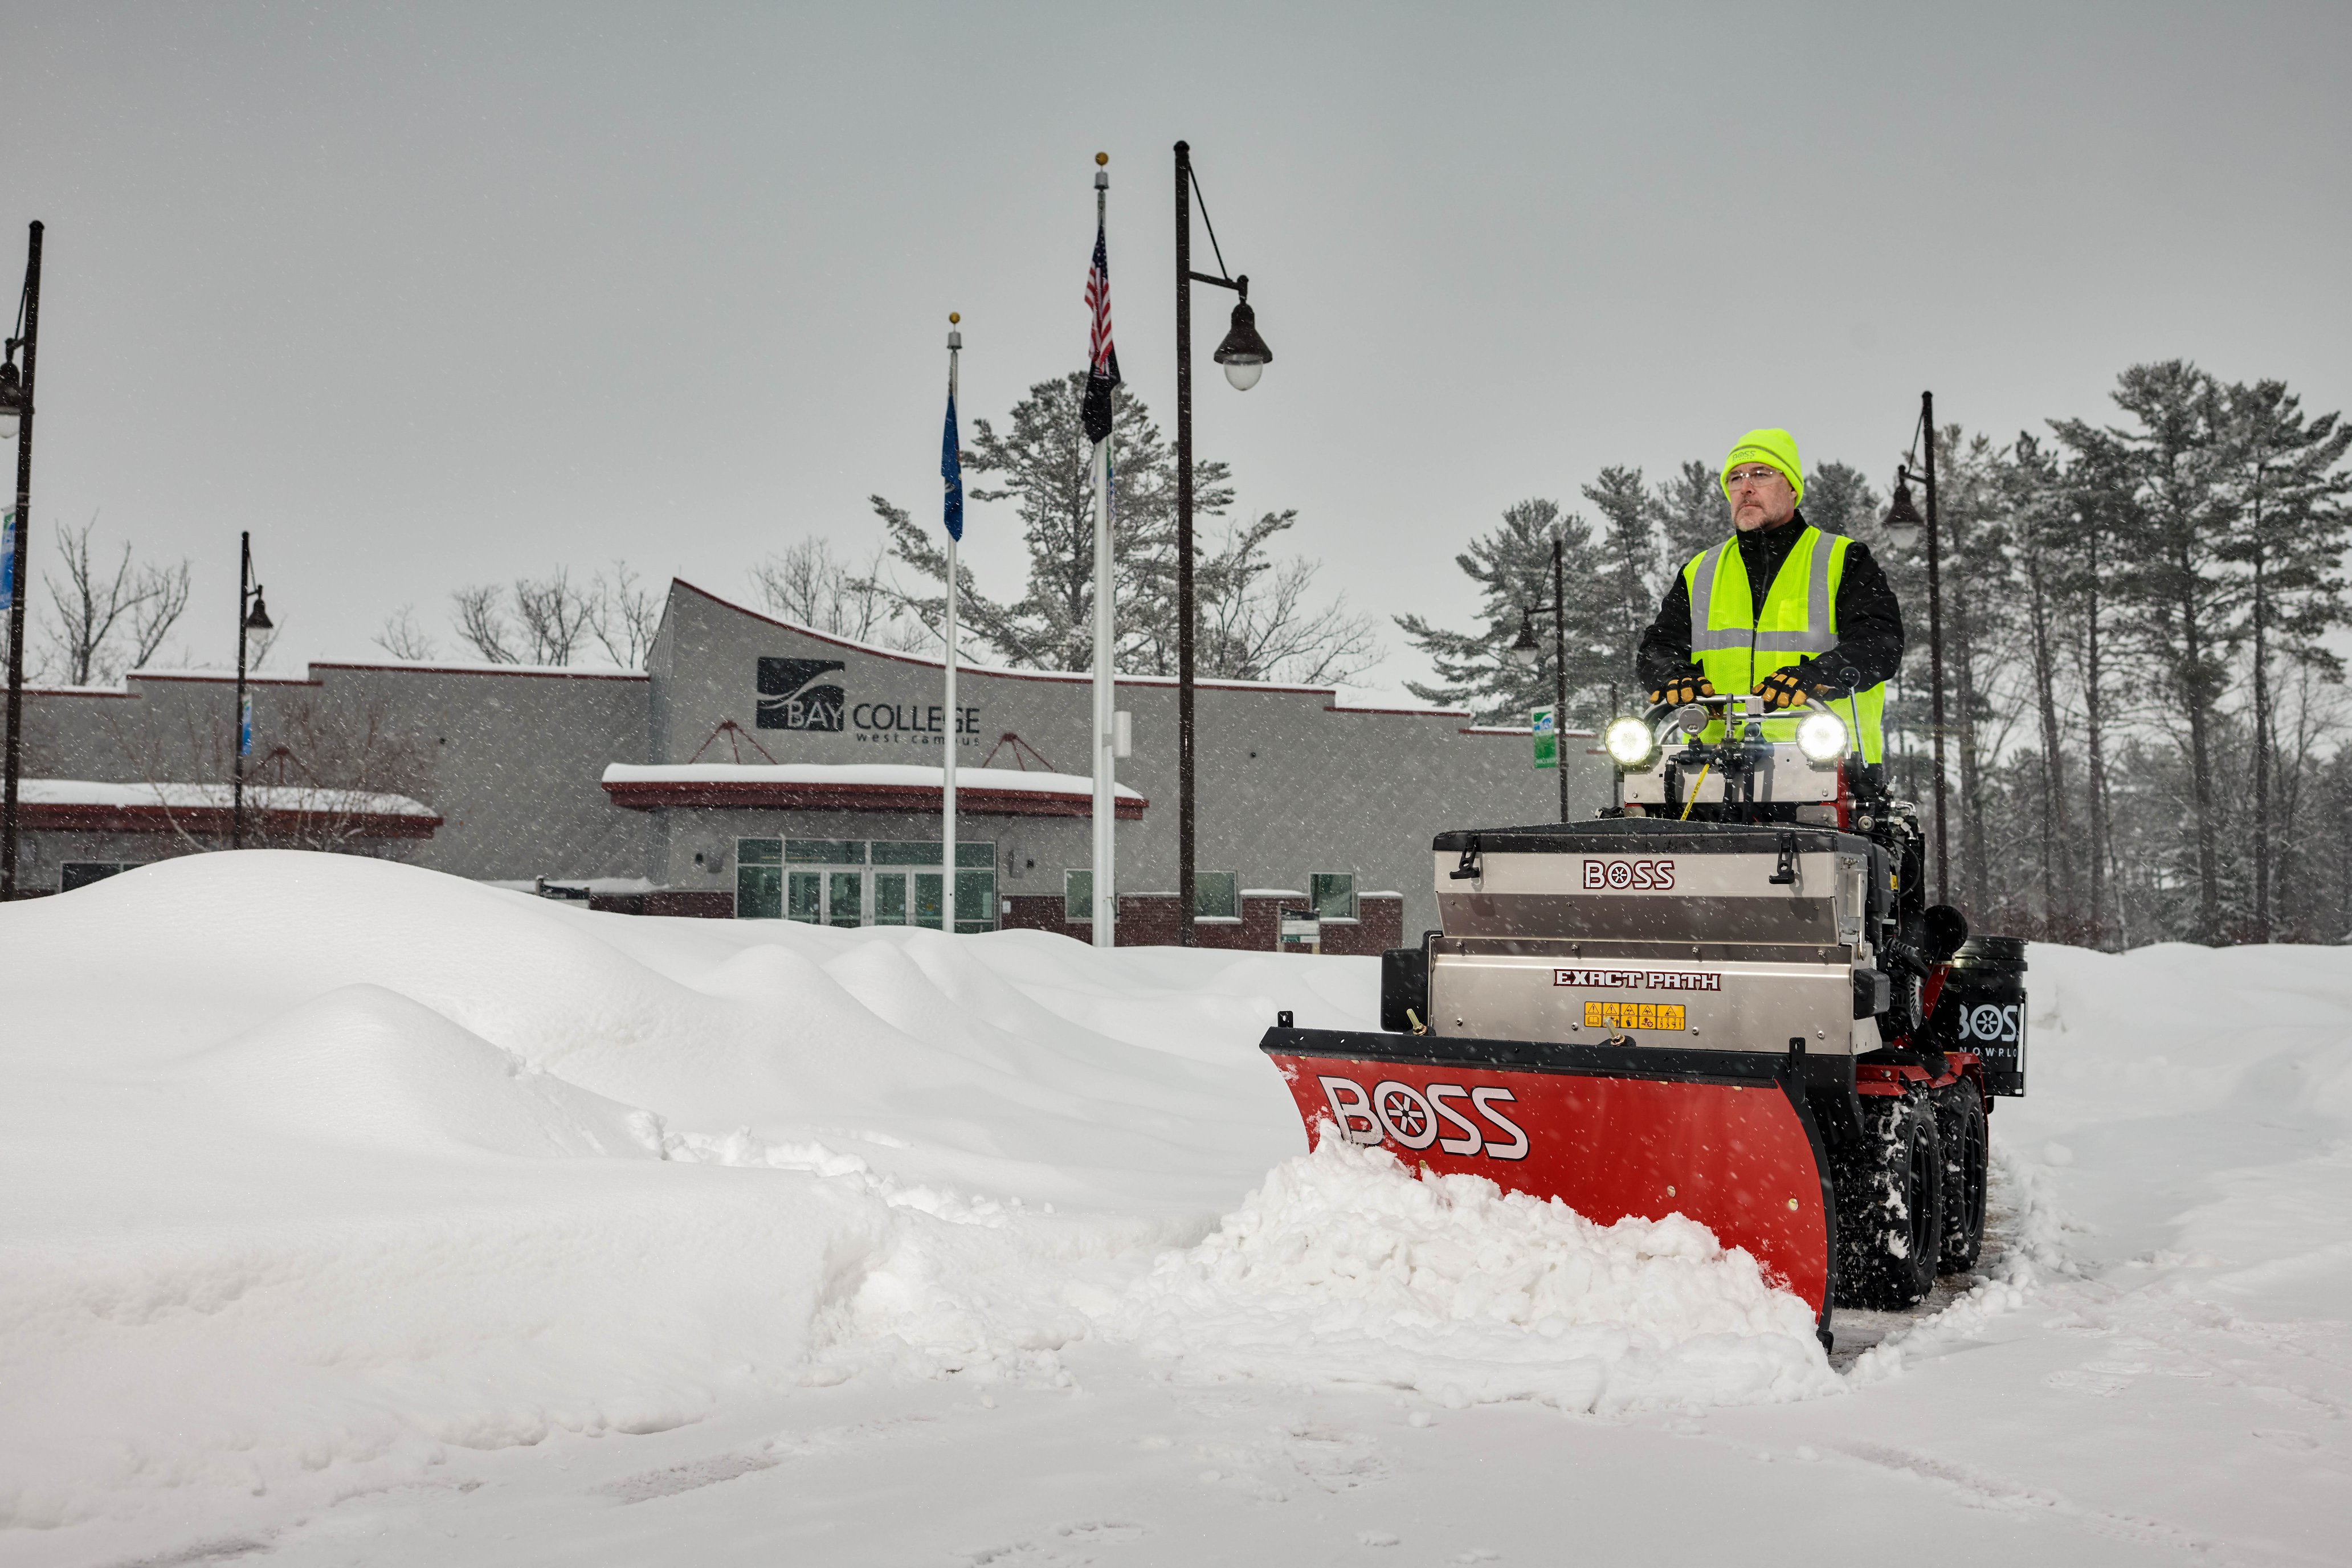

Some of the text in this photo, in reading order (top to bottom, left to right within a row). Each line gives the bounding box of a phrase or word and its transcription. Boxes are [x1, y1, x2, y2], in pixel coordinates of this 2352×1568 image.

[787, 701, 843, 729] BAY
[856, 733, 980, 746] west camus
[1583, 860, 1675, 891] BOSS
[1554, 969, 1721, 991] EXACT PATH
[1959, 1004, 2021, 1042] BOS
[1959, 1047, 2017, 1057] NOWPLO
[1317, 1075, 1530, 1161] BOSS
